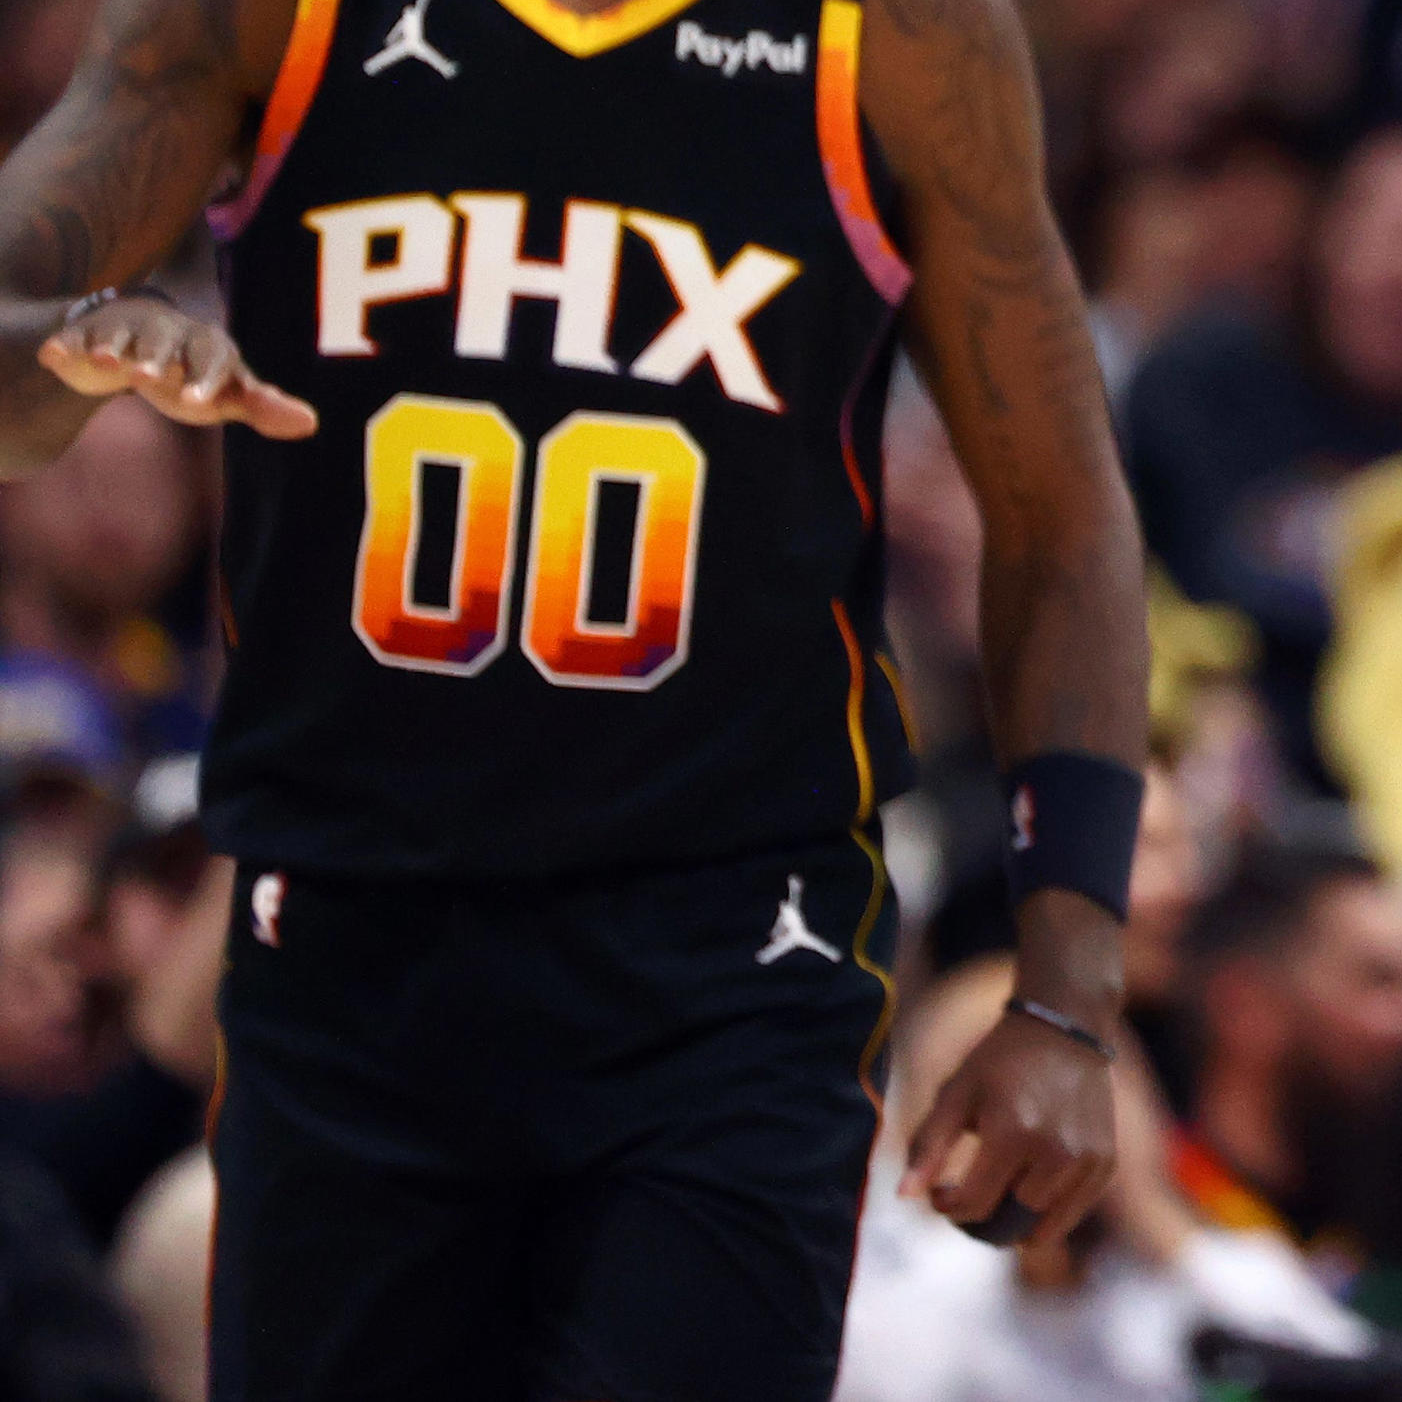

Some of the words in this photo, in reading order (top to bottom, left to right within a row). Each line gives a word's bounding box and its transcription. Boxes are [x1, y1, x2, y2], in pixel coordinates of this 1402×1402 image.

[674, 19, 808, 79] PayPal
[301, 190, 801, 415] PHX
[350, 392, 707, 693] 00
